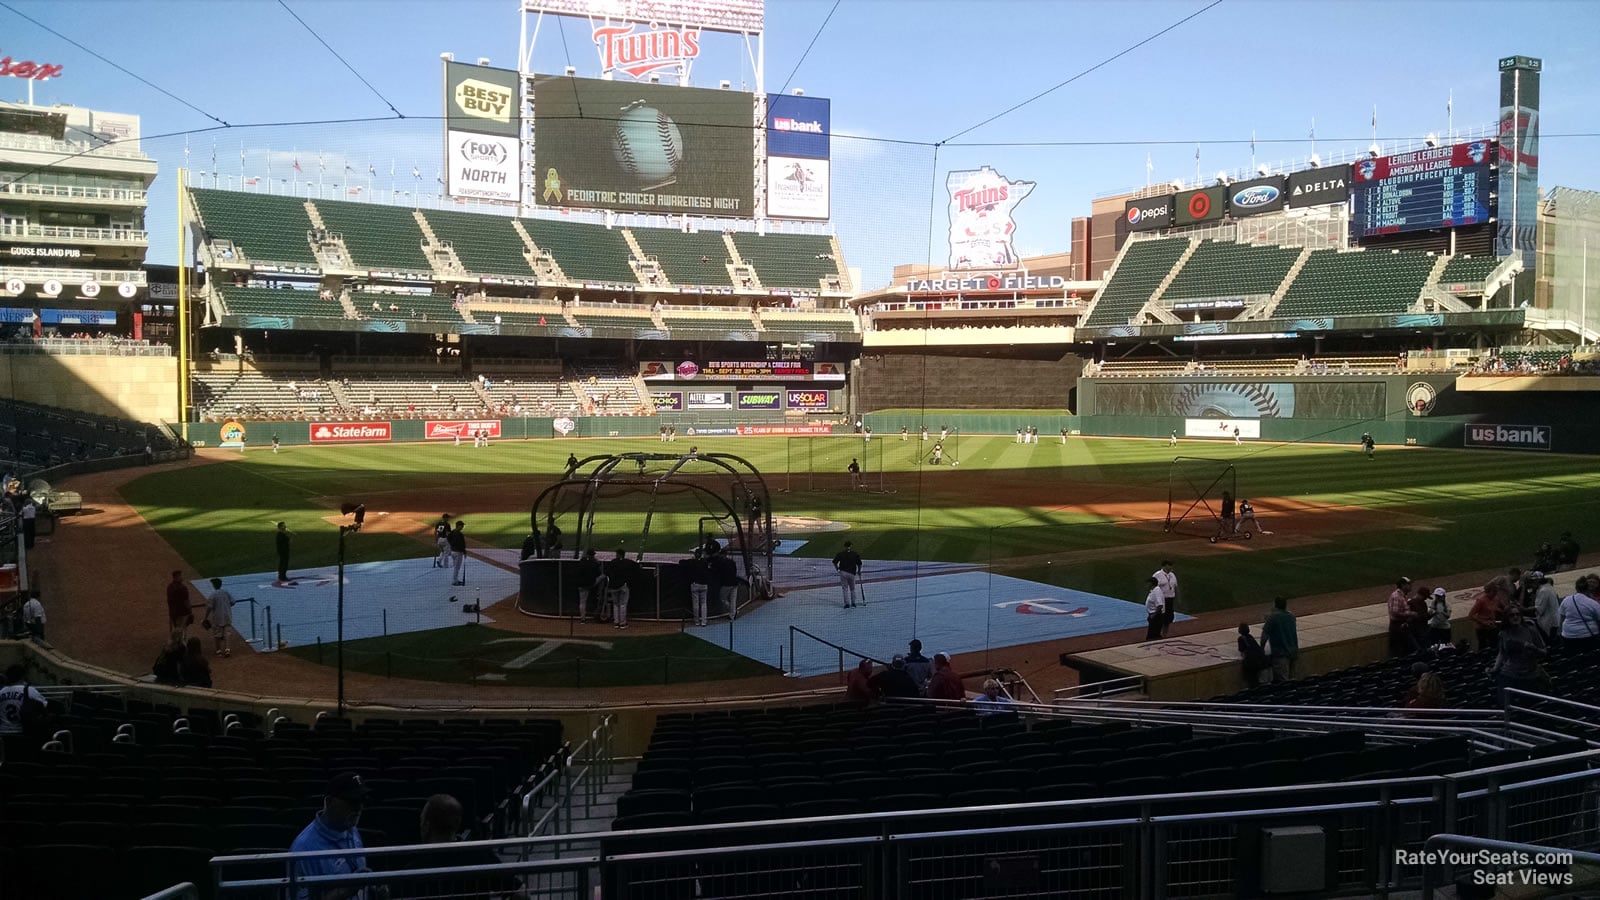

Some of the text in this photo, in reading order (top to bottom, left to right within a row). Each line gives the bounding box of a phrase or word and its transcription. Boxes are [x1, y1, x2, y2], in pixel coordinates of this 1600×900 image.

[592, 21, 700, 73] Twins
[464, 85, 509, 104] BEST
[464, 98, 504, 115] BUY
[470, 142, 498, 156] FOX
[1388, 146, 1454, 166] LEAGUE LEADERS
[1389, 159, 1452, 176] AMERICAN LEAGUE
[1416, 167, 1463, 180] PERCENTAGE
[462, 168, 506, 184] NORTH
[1306, 180, 1344, 192] DELTA
[568, 190, 740, 210] PEDIATRIC CANCER AWARENESS NIGHT
[954, 185, 1008, 212] Twins
[1242, 189, 1270, 204] Ford
[1141, 204, 1168, 224] pepsi
[1382, 217, 1406, 226] MACHADO
[10, 247, 80, 258] GOOSE ISLAND PUB
[908, 276, 1064, 291] TARGET FIELD
[740, 395, 778, 404] SUBWAY
[1472, 426, 1545, 444] usbank
